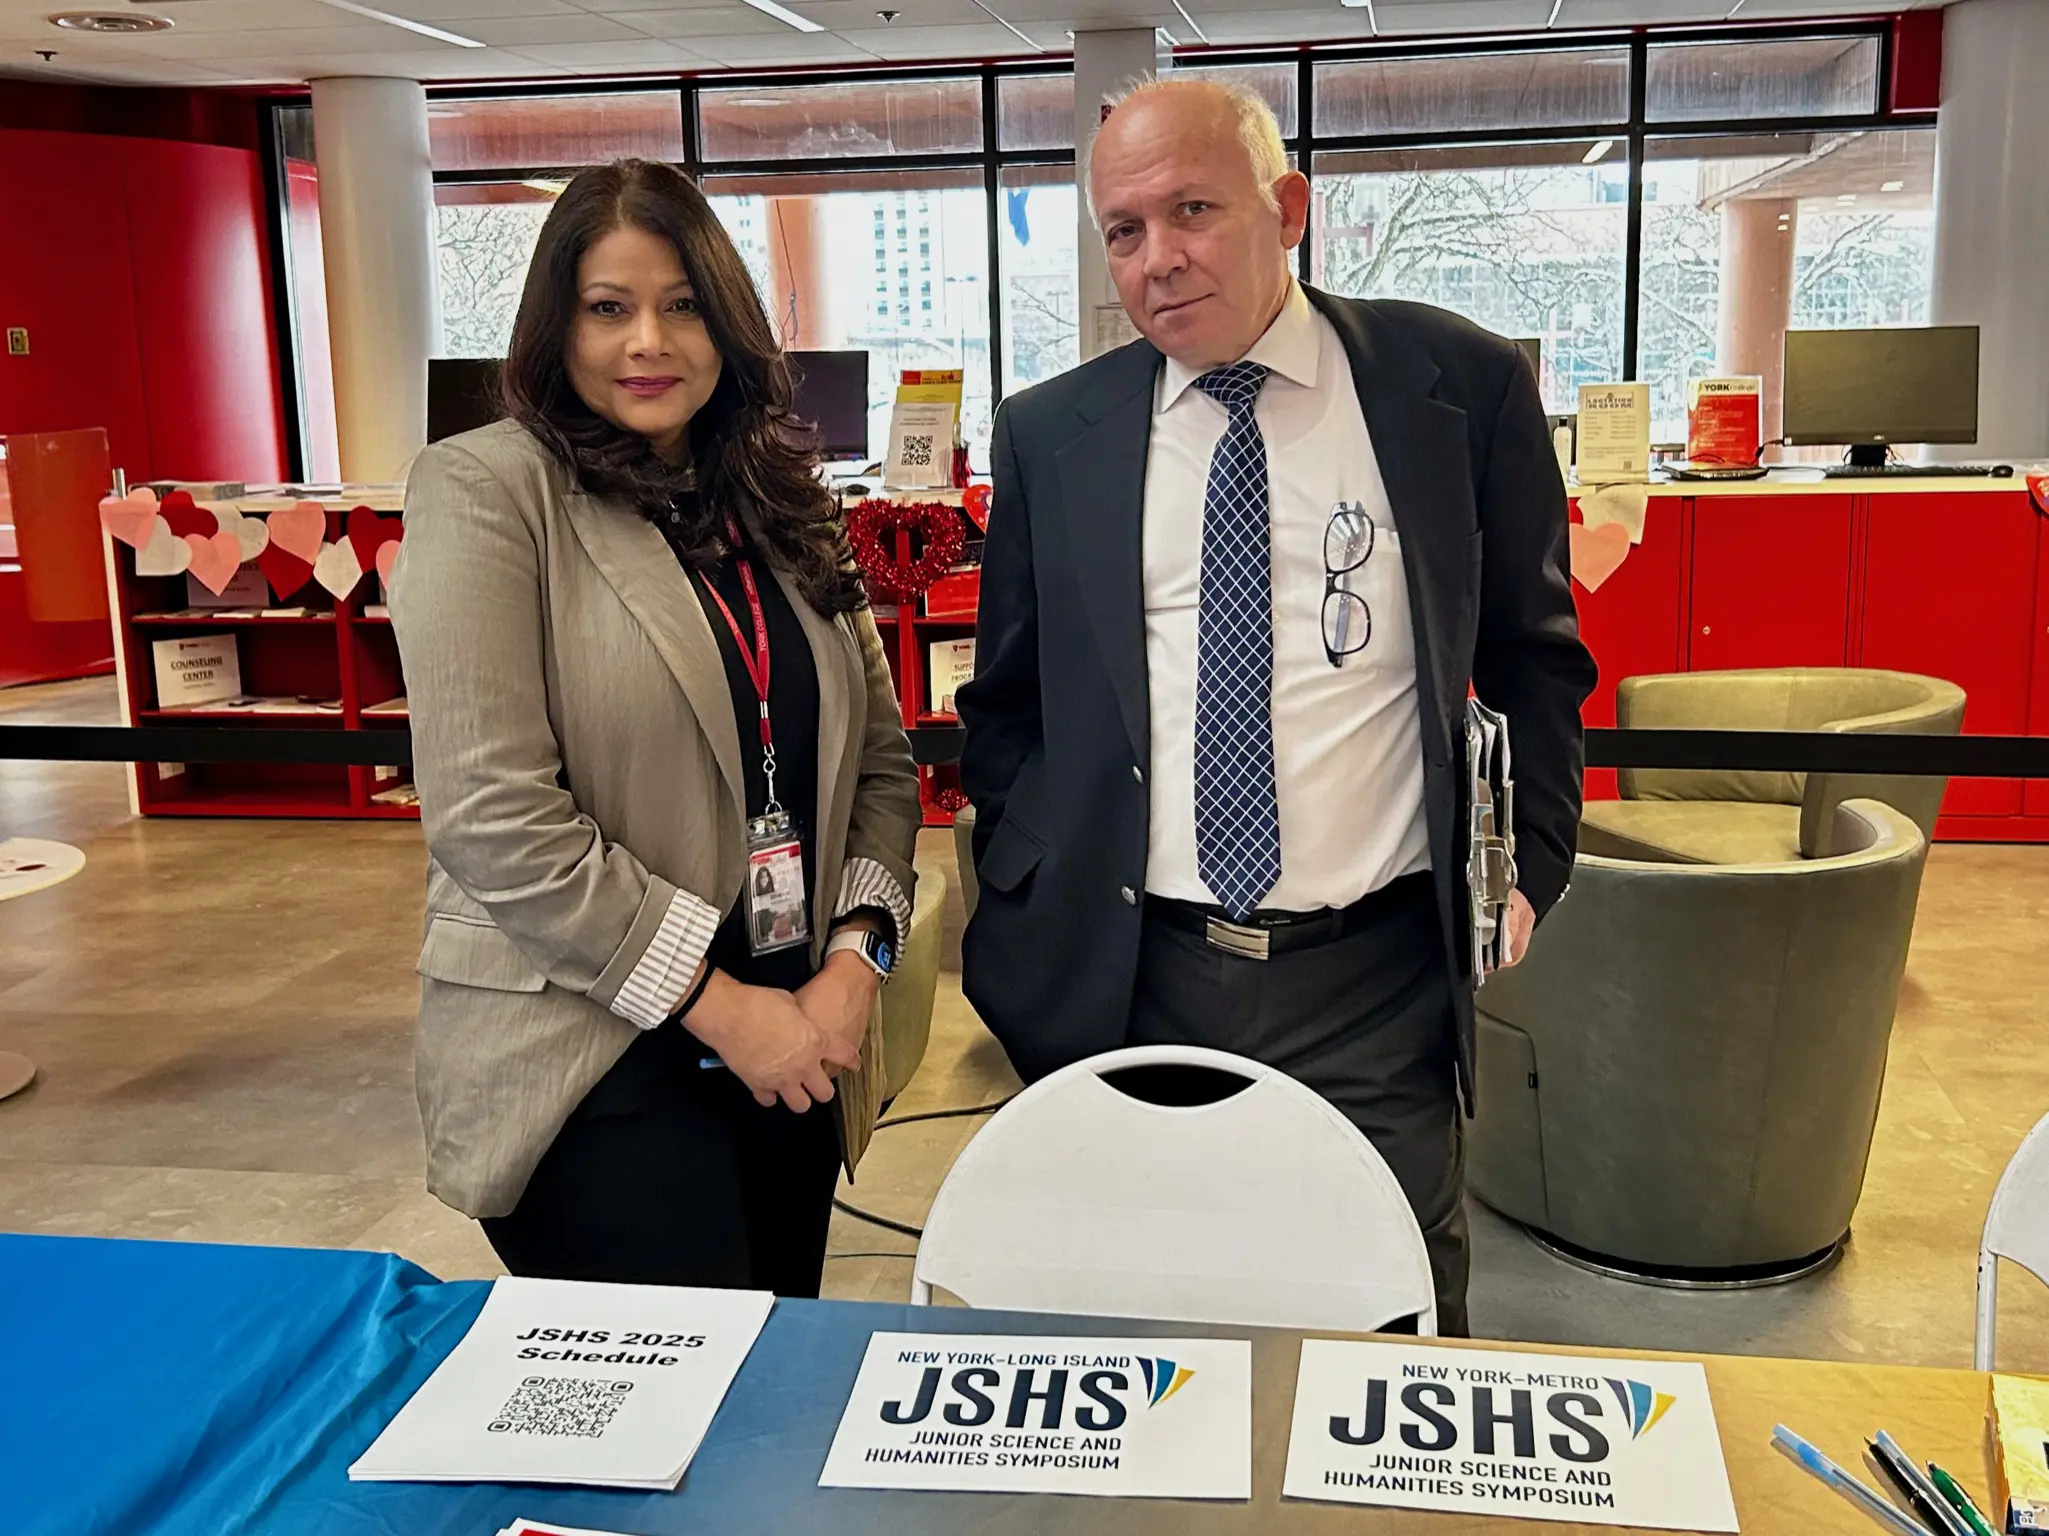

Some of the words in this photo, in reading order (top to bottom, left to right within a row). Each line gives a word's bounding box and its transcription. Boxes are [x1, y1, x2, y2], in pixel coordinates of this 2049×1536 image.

[1704, 384, 1730, 392] YORK
[751, 603, 764, 632] COLLEGE
[758, 632, 767, 652] YORK
[170, 656, 223, 670] COUNSELING
[182, 670, 214, 681] CENTER
[517, 1327, 611, 1344] JSHS
[619, 1332, 706, 1348] 2025
[517, 1347, 679, 1367] Schedule
[897, 1351, 941, 1364] NEW
[1063, 1355, 1130, 1368] ISLAND
[1402, 1364, 1449, 1380] NEW
[879, 1367, 1129, 1431] JSHS
[1328, 1378, 1610, 1463] JSHS
[908, 1431, 983, 1447] JUNIOR
[989, 1434, 1074, 1450] SCIENCE
[1080, 1437, 1122, 1451] AND
[864, 1448, 989, 1466] HUMANITIES
[994, 1453, 1120, 1470] SYMPOSIUM
[1369, 1454, 1453, 1475] JUNIOR
[1460, 1461, 1558, 1483] SCIENCE
[1564, 1469, 1611, 1487] AND
[1324, 1471, 1464, 1496] HUMANITIES
[1472, 1482, 1615, 1508] SYMPOSIUM
